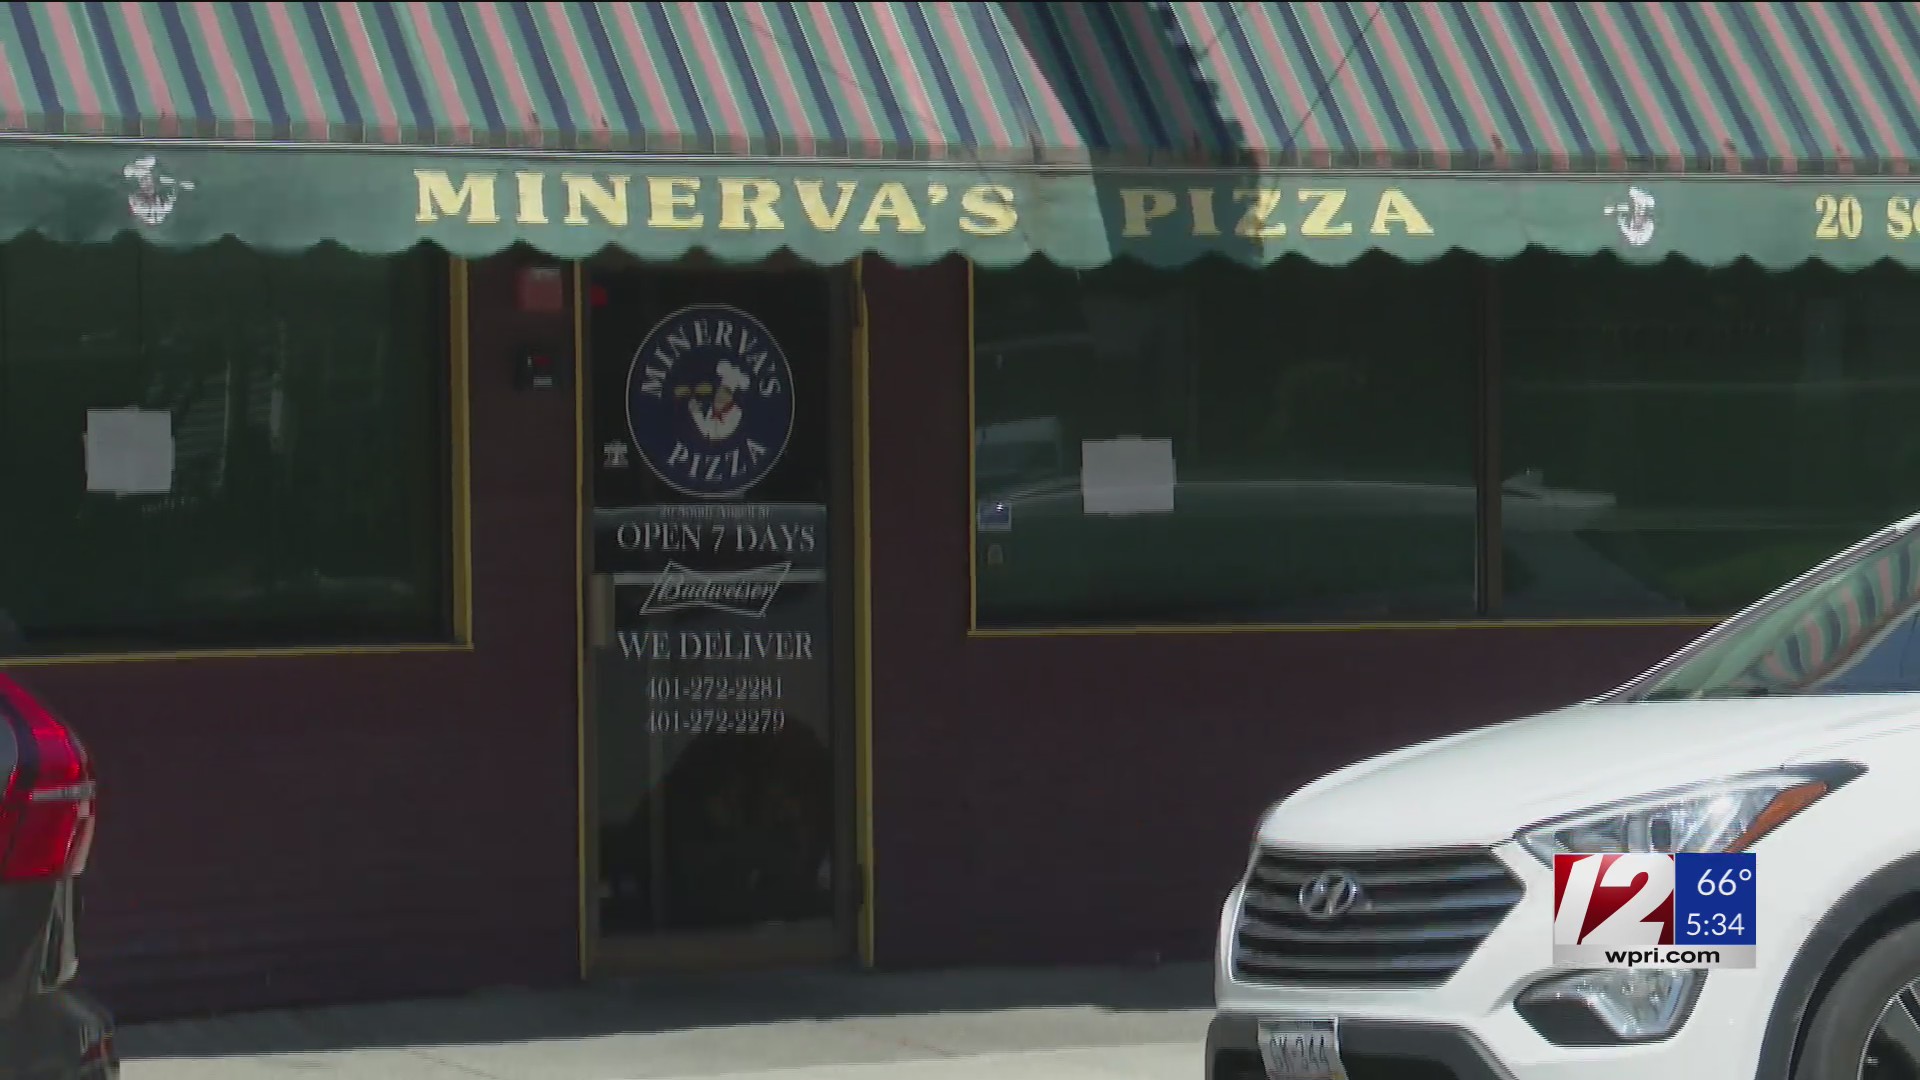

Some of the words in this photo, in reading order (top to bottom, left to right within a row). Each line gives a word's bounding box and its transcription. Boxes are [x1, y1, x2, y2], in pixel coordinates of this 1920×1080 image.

[414, 169, 1019, 235] MINERVA'S
[1120, 188, 1434, 236] PIZZA
[1815, 194, 1863, 240] 20
[641, 319, 781, 398] MINERVA'S
[667, 437, 768, 481] PIZZA
[616, 522, 700, 551] OPEN
[711, 524, 726, 554] 7
[735, 523, 815, 551] DAYS
[617, 631, 670, 660] WE
[679, 631, 813, 660] DELIVER
[646, 676, 782, 701] 401-272-2281
[646, 709, 785, 733] 401-272-2279
